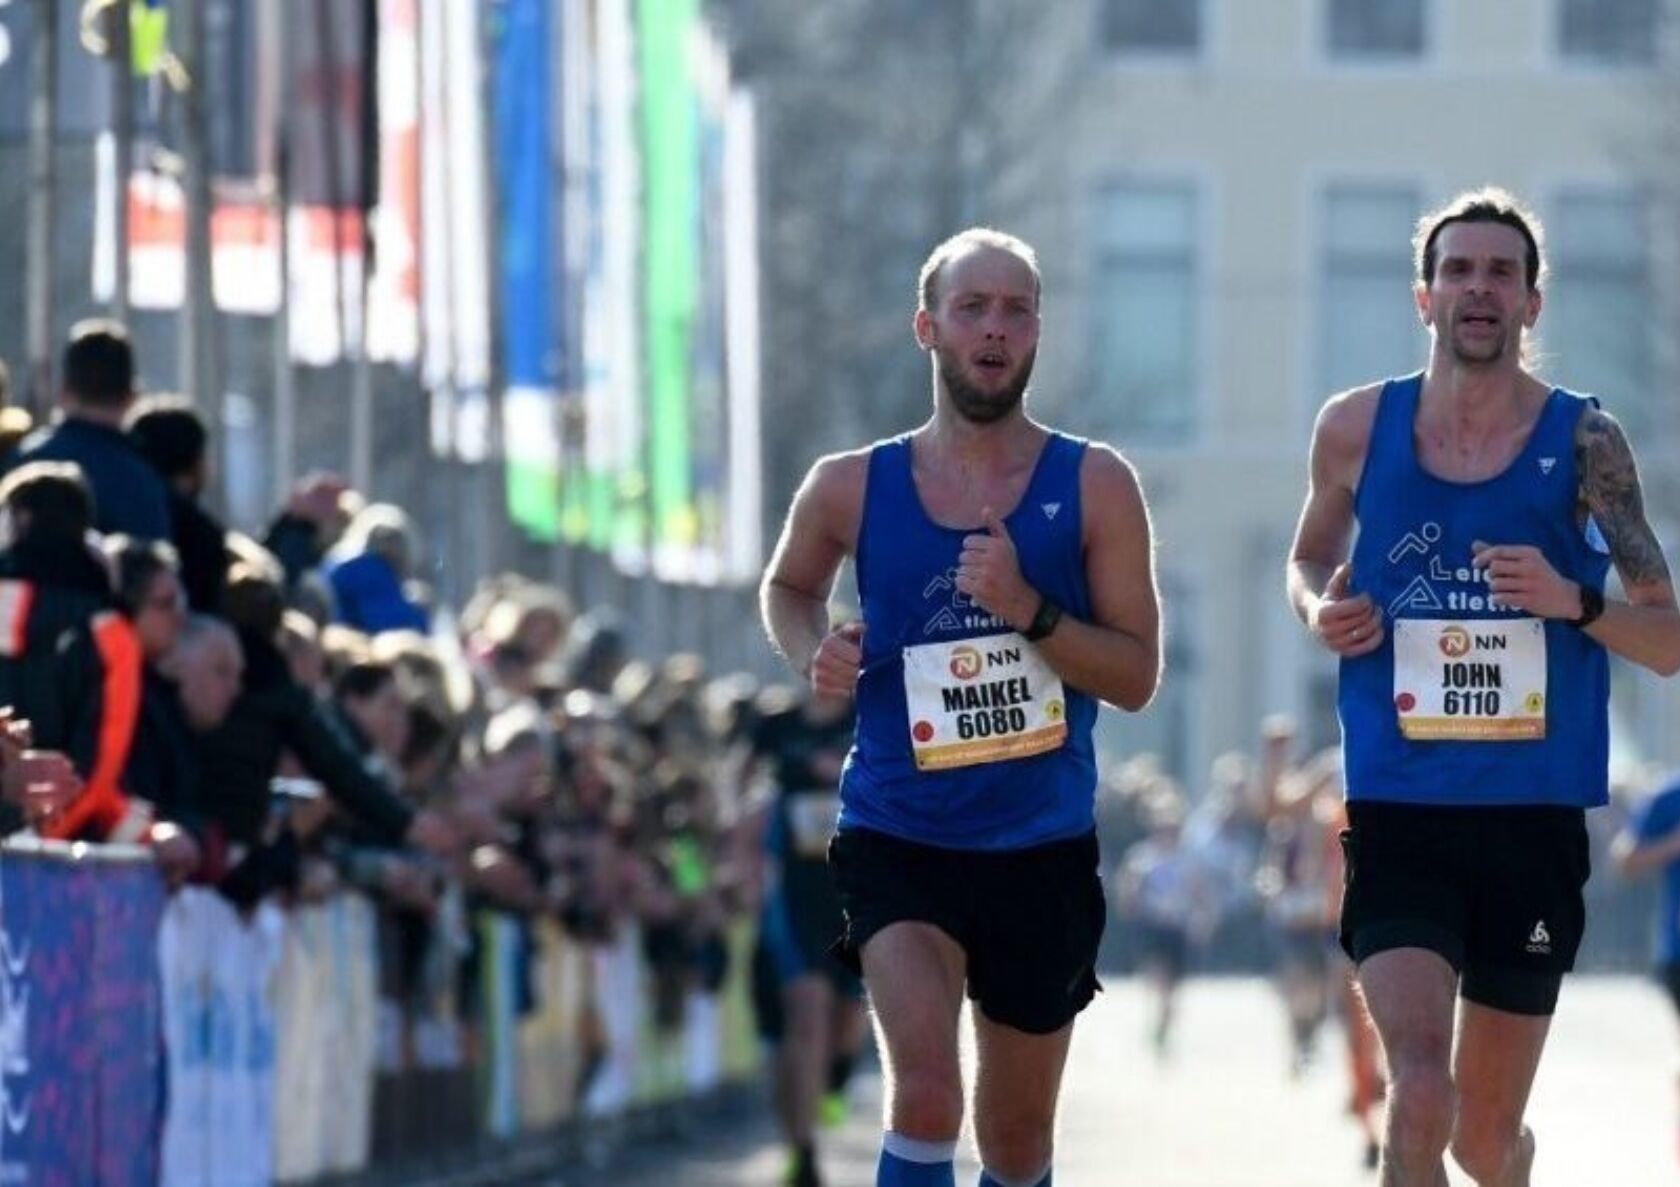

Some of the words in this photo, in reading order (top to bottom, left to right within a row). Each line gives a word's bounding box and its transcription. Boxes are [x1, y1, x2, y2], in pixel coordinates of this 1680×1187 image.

[1475, 634, 1506, 650] NN
[986, 647, 1021, 667] NN
[1442, 662, 1501, 688] JOHN
[941, 676, 1033, 713] MAIKEL
[1443, 690, 1500, 716] 6110
[956, 706, 1026, 740] 6080
